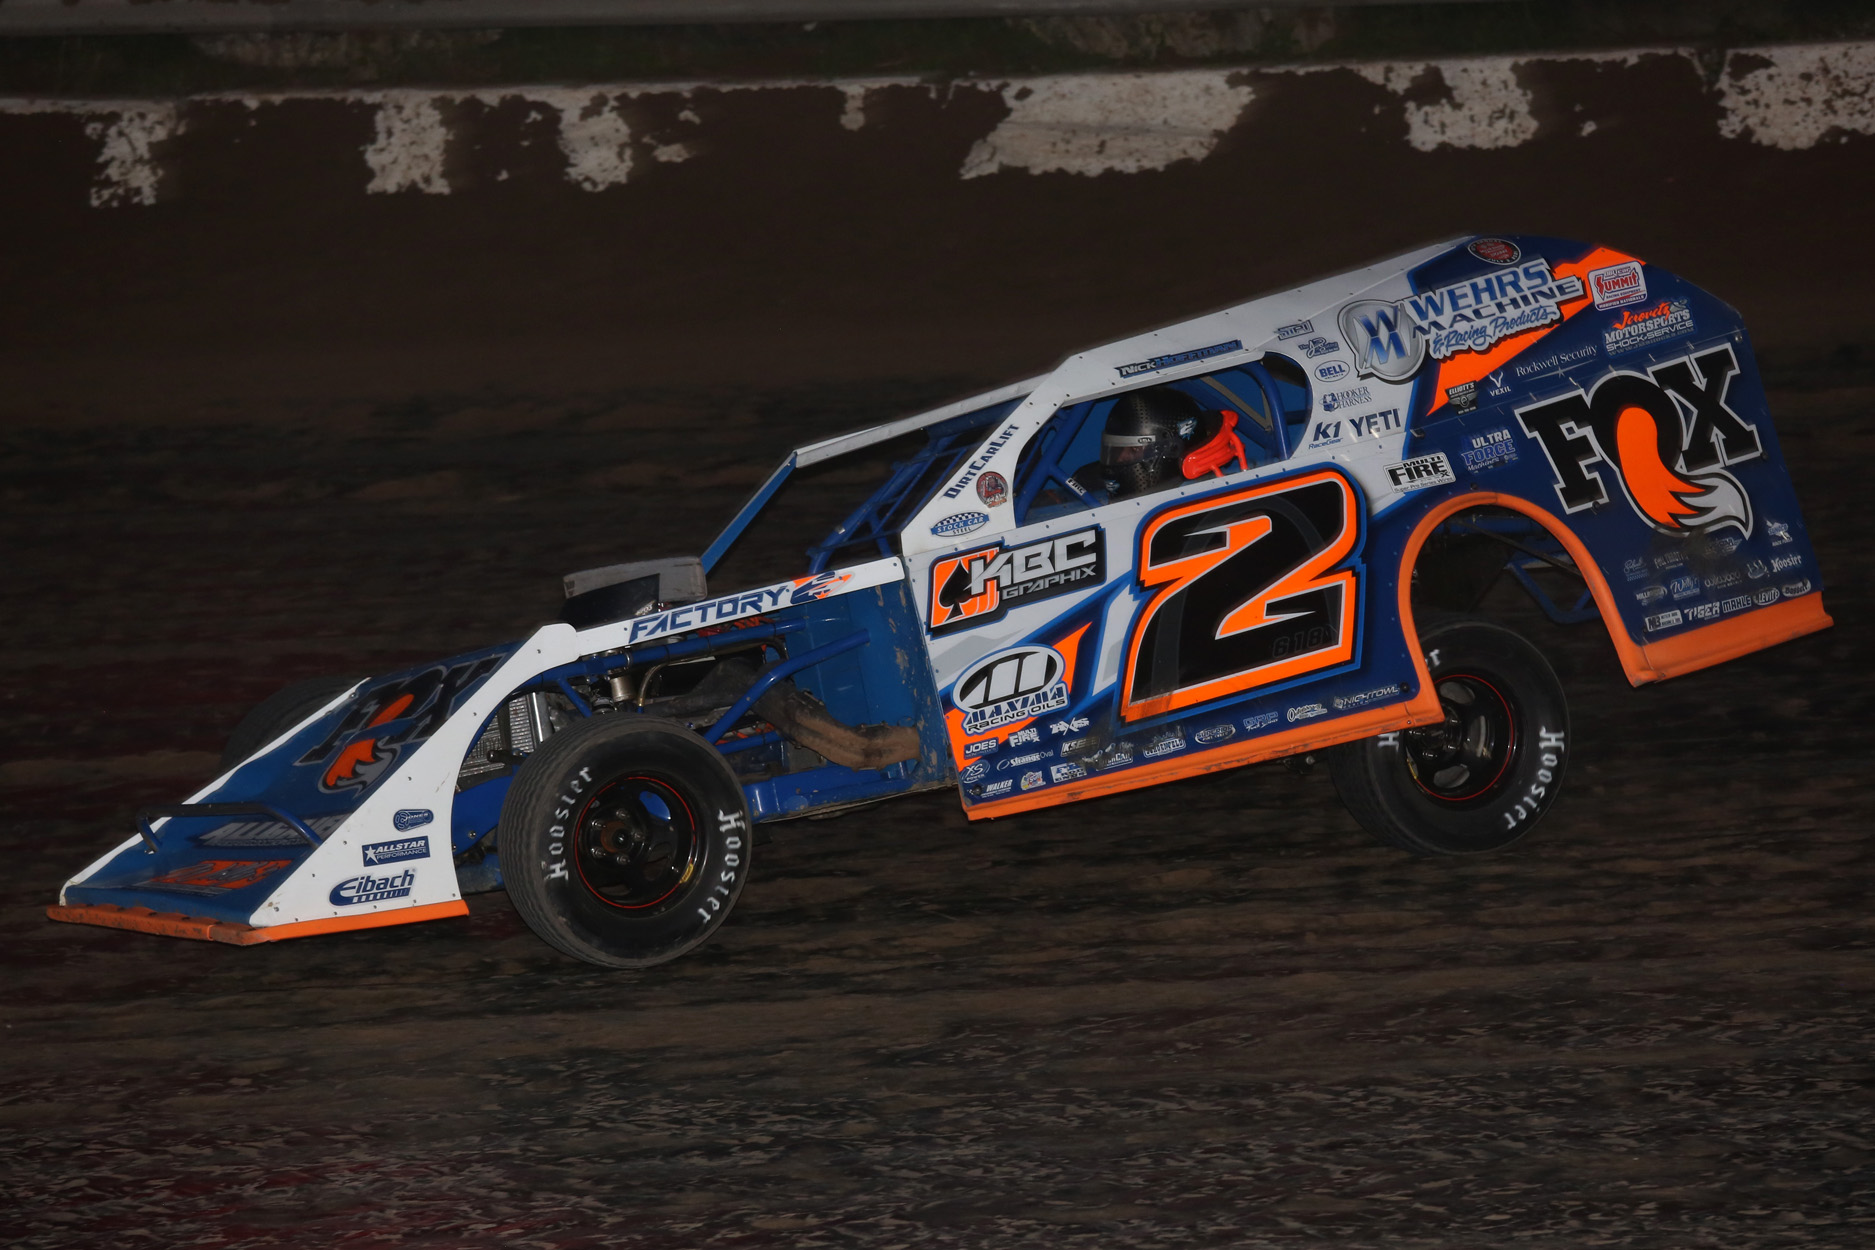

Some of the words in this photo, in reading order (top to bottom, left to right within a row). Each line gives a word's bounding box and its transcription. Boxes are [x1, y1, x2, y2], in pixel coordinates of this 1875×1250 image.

[1409, 262, 1550, 321] WEHRS
[1412, 280, 1582, 339] MACHINE
[1444, 323, 1489, 352] Racing
[1489, 304, 1557, 341] Products
[1604, 309, 1691, 345] MOTORSPORTS
[1318, 364, 1346, 378] BELL
[1516, 356, 1559, 377] Rockwell
[1559, 345, 1597, 364] Security
[1336, 386, 1370, 402] HOOKER
[1449, 381, 1475, 395] ELLIOTT'S
[1489, 385, 1512, 397] VEXIL
[1337, 394, 1373, 409] HARNESS
[1313, 421, 1343, 442] K1
[1349, 408, 1402, 438] YETI
[1514, 342, 1763, 520] FOX
[1472, 428, 1511, 449] ULTRA
[1402, 455, 1442, 468] MULTI
[1460, 439, 1516, 466] FORCE
[1388, 460, 1447, 487] FIRE
[937, 521, 965, 533] STOCK
[967, 516, 985, 526] CAR
[952, 526, 972, 535] STEEL
[963, 527, 1097, 596] KBC
[1770, 554, 1802, 573] Hoosier
[1122, 472, 1356, 720] 2
[1722, 596, 1751, 613] MAHLE
[628, 586, 789, 644] FACTORY
[1683, 601, 1720, 621] TIGER
[965, 686, 1065, 725] MAXIMA
[1030, 698, 1066, 713] OILS
[966, 739, 997, 754] JOES
[1039, 749, 1054, 759] Oval
[1062, 738, 1086, 754] KSE
[966, 763, 984, 778] XS
[1504, 725, 1566, 830] Hoosier
[986, 779, 1013, 793] WALKER
[541, 766, 593, 881] Hoosier
[375, 839, 426, 854] ALLSTAR
[376, 848, 427, 860] PERFORMANCE
[697, 808, 746, 924] Hoosier
[329, 870, 416, 906] Eibach
